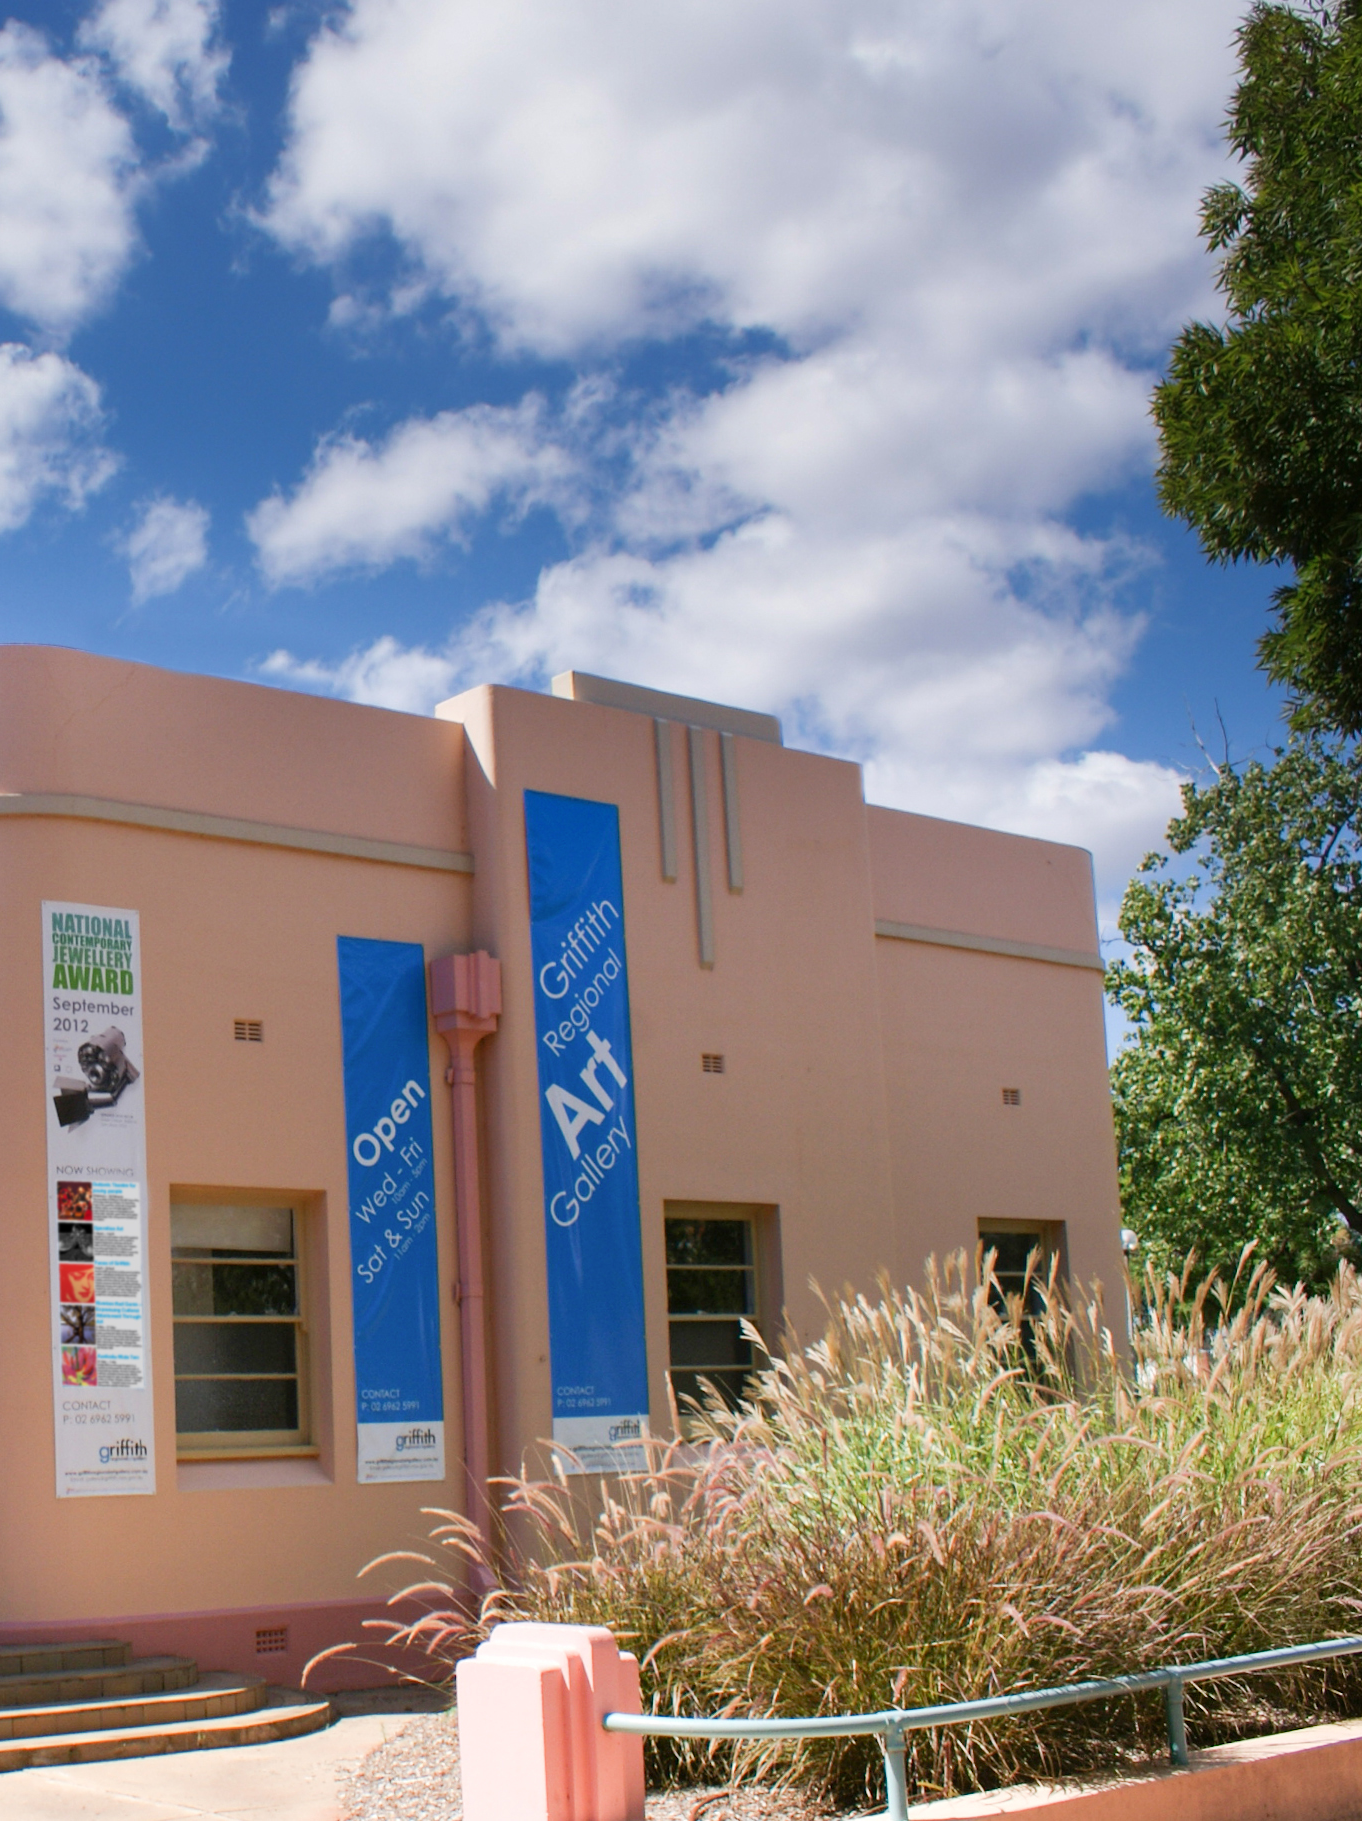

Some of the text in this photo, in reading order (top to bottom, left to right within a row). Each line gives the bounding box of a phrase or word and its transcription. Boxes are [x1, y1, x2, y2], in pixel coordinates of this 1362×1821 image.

[51, 911, 133, 939] NATIONAL
[51, 932, 133, 952] CONTEMPORARY
[539, 900, 619, 999] Griffith
[51, 945, 133, 970] JEWELLERY
[52, 963, 134, 996] AWARD
[53, 996, 135, 1017] September
[543, 947, 622, 1057] Regional
[53, 1017, 89, 1033] 2012
[544, 1029, 628, 1161] Art
[353, 1079, 426, 1167] Open
[56, 1165, 134, 1177] NOW SHOWING
[355, 1171, 398, 1224] Wed
[399, 1136, 424, 1167] Fri
[550, 1115, 632, 1227] Gallery
[357, 1191, 430, 1284] Sat & Sun
[361, 1389, 400, 1399] CONTACT
[557, 1385, 595, 1396] CONTACT
[62, 1400, 111, 1411] CONTACT
[361, 1400, 420, 1412] P: 02 6962 5991
[63, 1414, 136, 1425] P: 02 6962 5991
[98, 1438, 148, 1464] griffith
[395, 1428, 436, 1452] griffith
